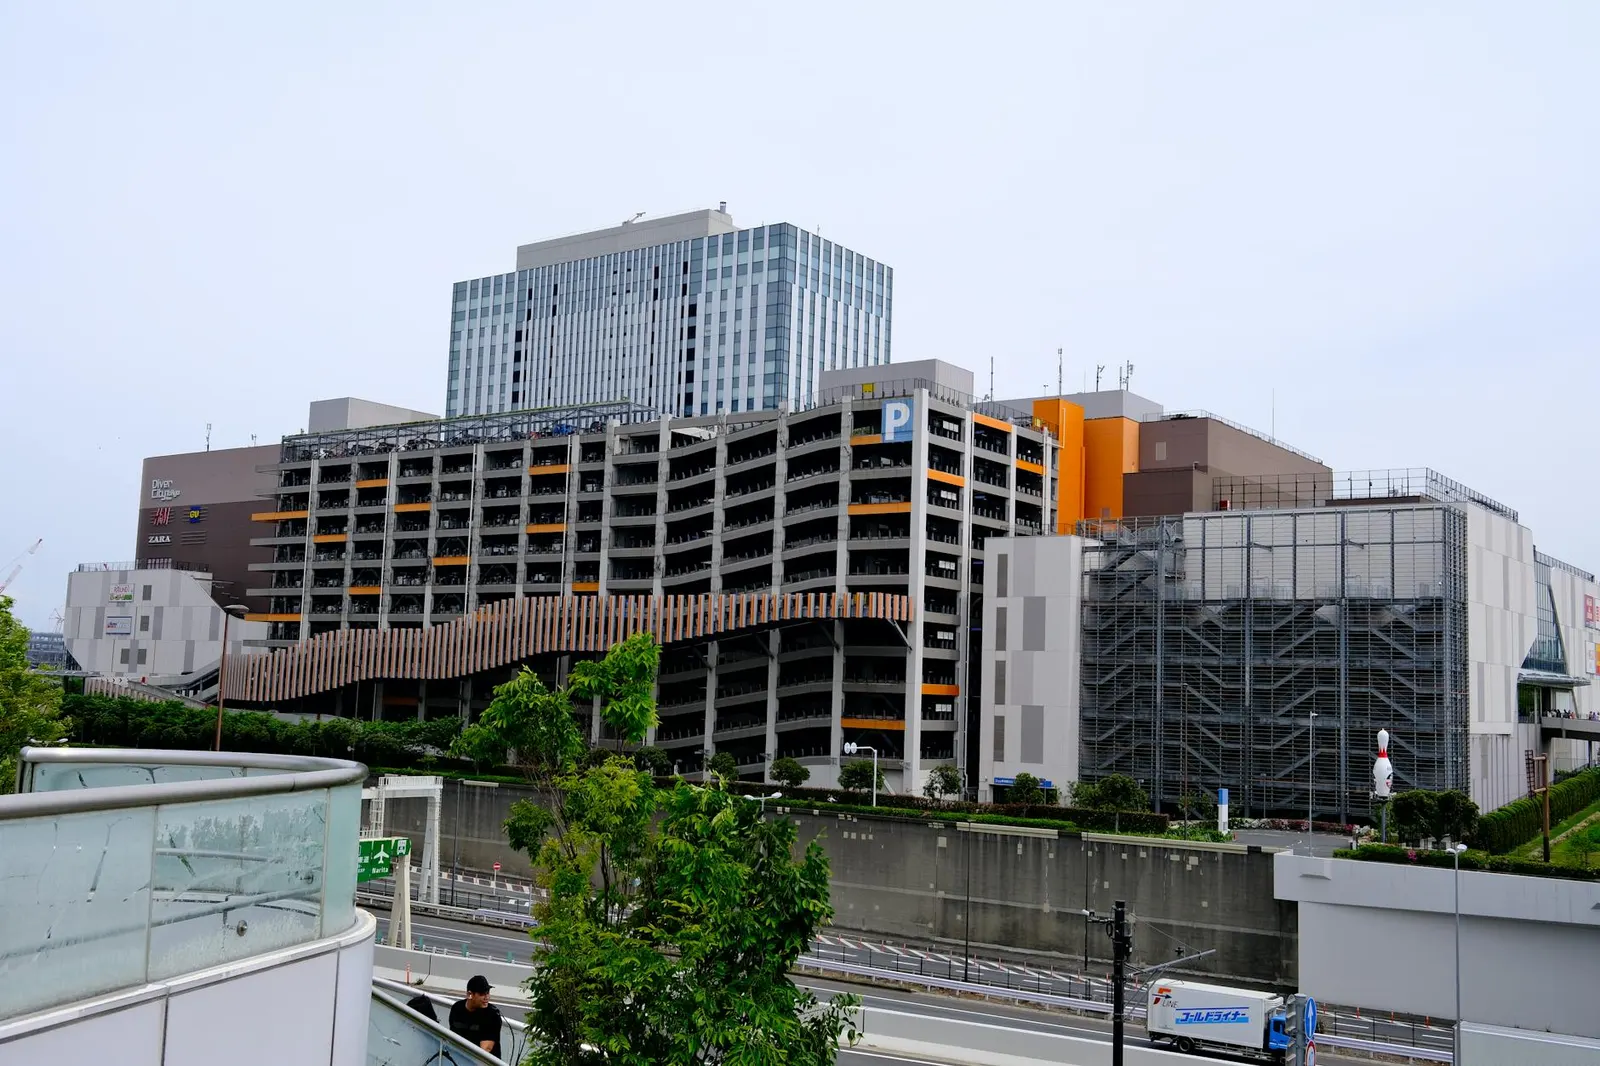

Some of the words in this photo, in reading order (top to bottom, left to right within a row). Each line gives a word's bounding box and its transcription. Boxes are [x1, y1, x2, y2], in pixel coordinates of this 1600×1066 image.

[885, 403, 910, 441] P
[152, 479, 173, 488] Diver
[189, 510, 200, 518] GU
[148, 535, 171, 543] ZARA
[372, 866, 389, 874] Narita
[1180, 1011, 1247, 1022] コールドライナー
